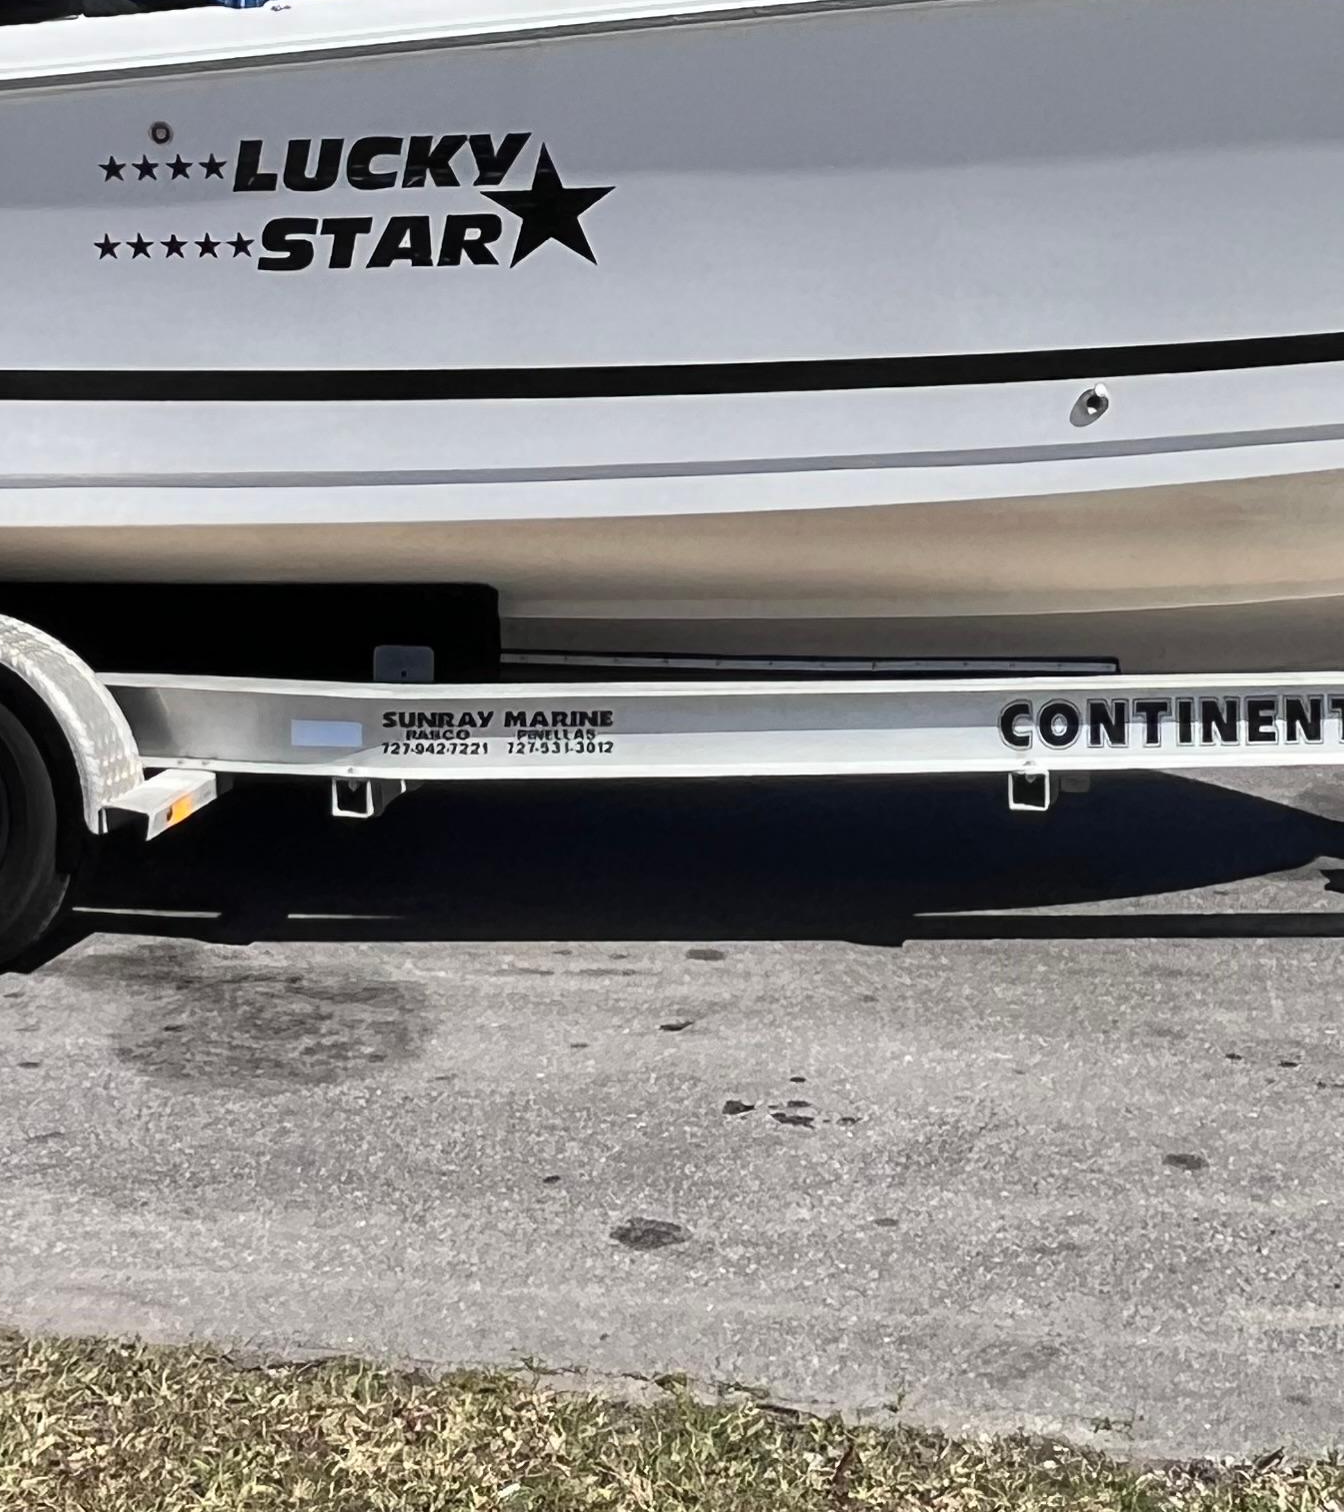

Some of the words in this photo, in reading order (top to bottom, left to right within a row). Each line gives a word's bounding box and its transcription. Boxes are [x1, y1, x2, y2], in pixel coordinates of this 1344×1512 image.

[233, 133, 532, 192] LUCKY
[258, 214, 502, 271] STAR
[382, 711, 494, 728] SUNRAY
[504, 711, 614, 727] MARINE
